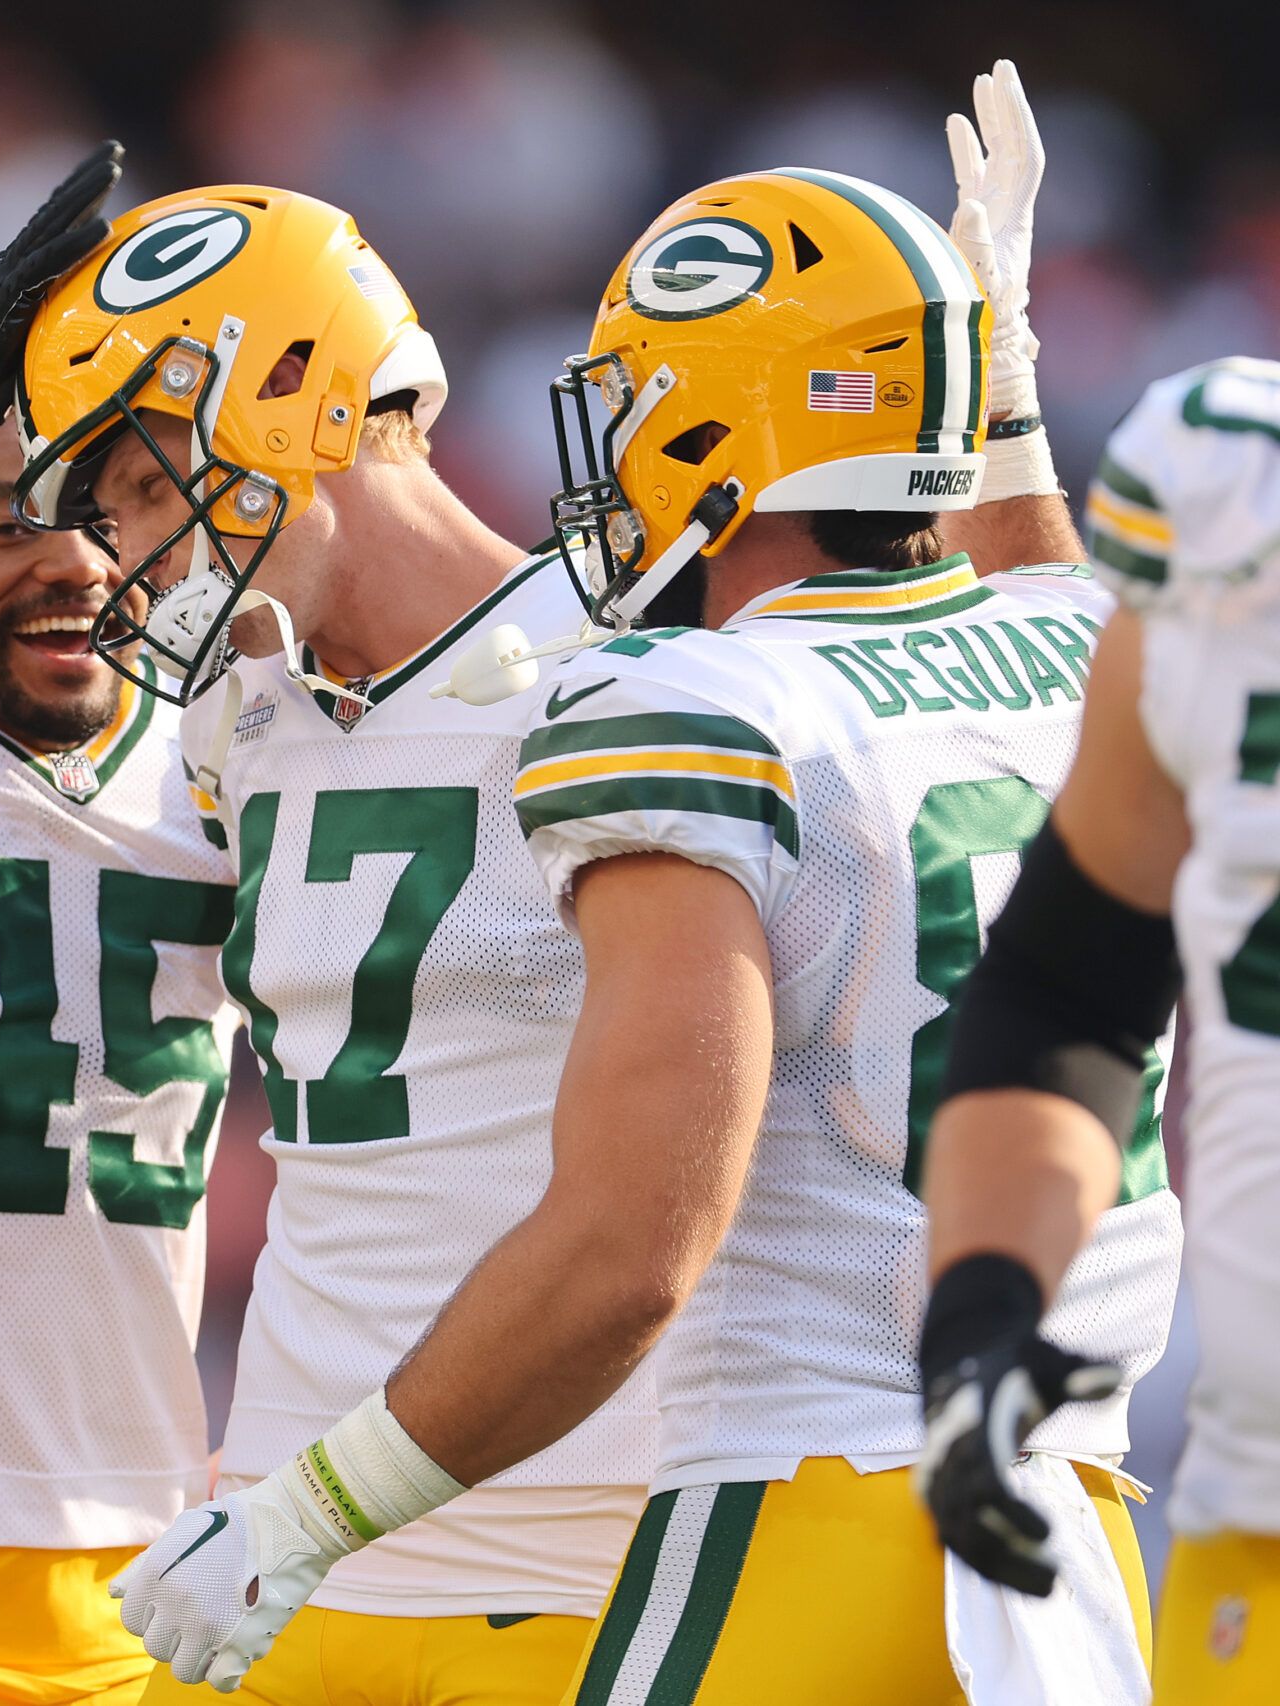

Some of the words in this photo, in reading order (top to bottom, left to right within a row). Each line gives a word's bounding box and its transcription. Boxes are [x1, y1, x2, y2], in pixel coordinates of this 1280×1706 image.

[907, 469, 976, 496] PACKERS
[338, 697, 361, 720] NFL
[61, 767, 91, 790] NFL
[220, 786, 479, 1144] 17
[300, 1461, 322, 1497] NAME
[328, 1507, 354, 1537] PLAY
[332, 1484, 357, 1516] PLAY
